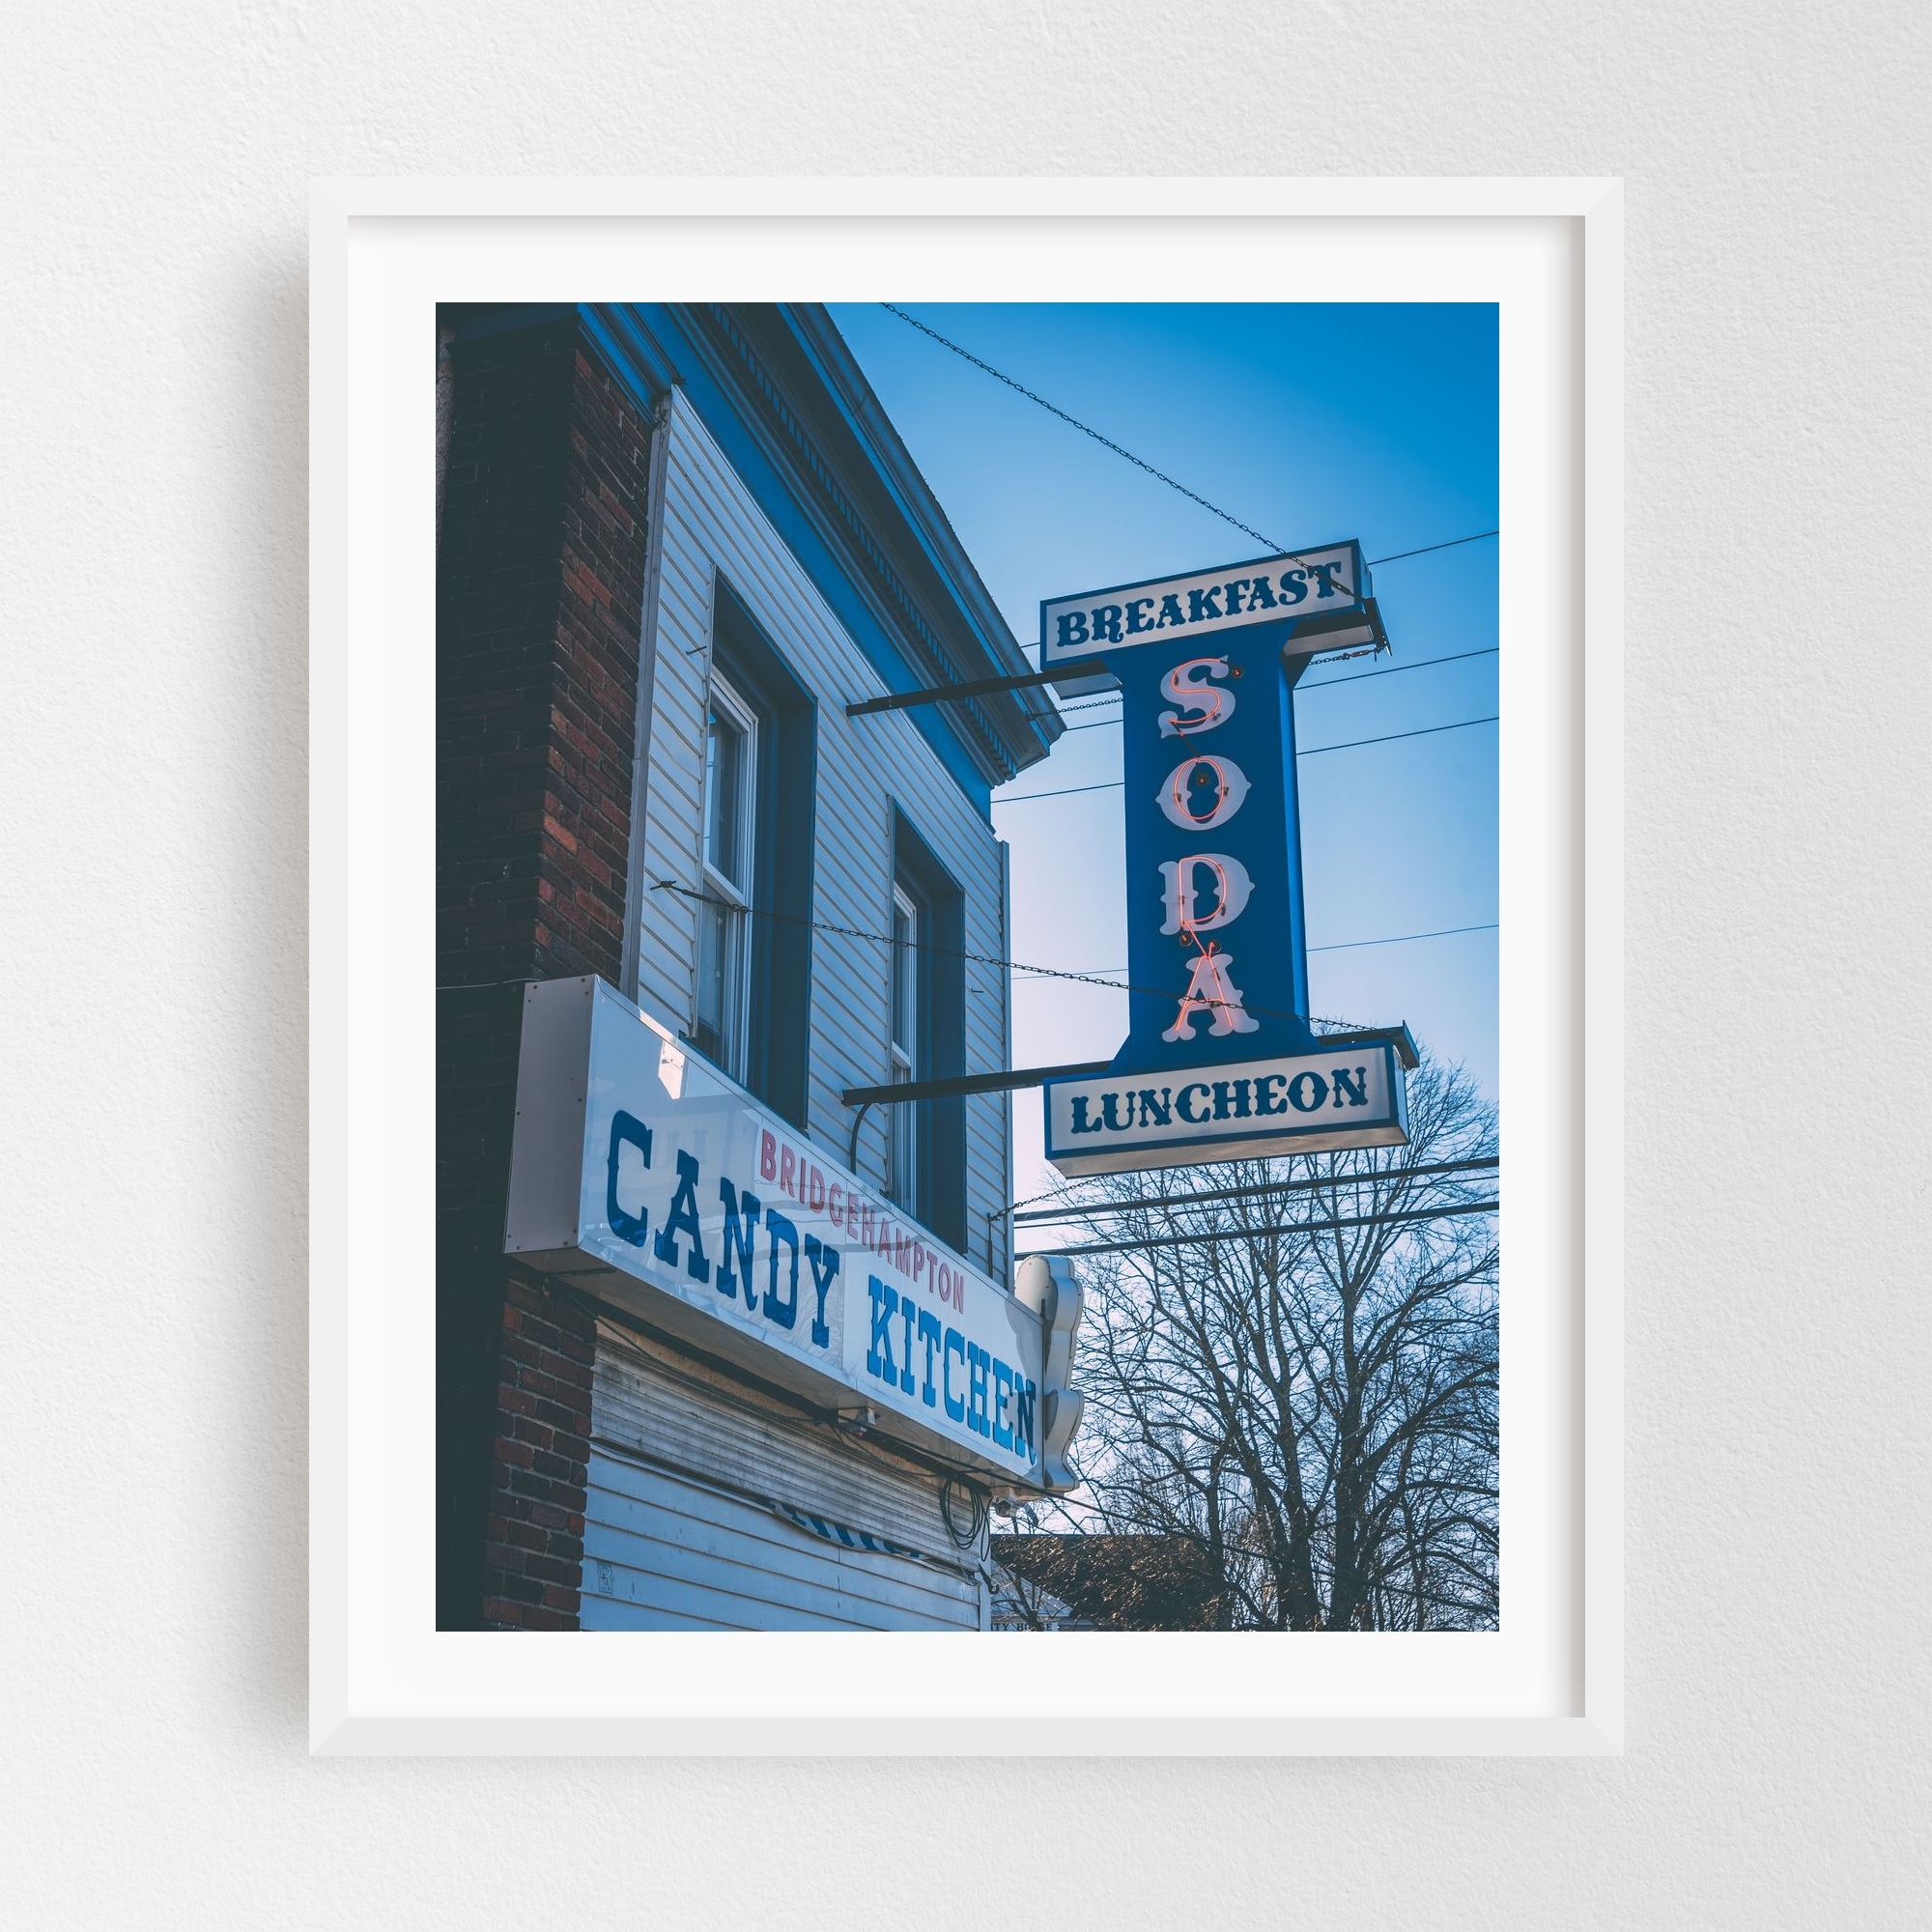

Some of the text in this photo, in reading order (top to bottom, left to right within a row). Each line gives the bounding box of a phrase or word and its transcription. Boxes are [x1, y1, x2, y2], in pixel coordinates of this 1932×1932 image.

[1056, 561, 1342, 647] BREAKFAST
[1155, 654, 1260, 1042] SODA
[1070, 1066, 1368, 1134] LUNCHEON
[606, 1109, 1037, 1466] CANDY KITCHEN
[759, 1128, 965, 1315] BRIDGEHAMPTON
